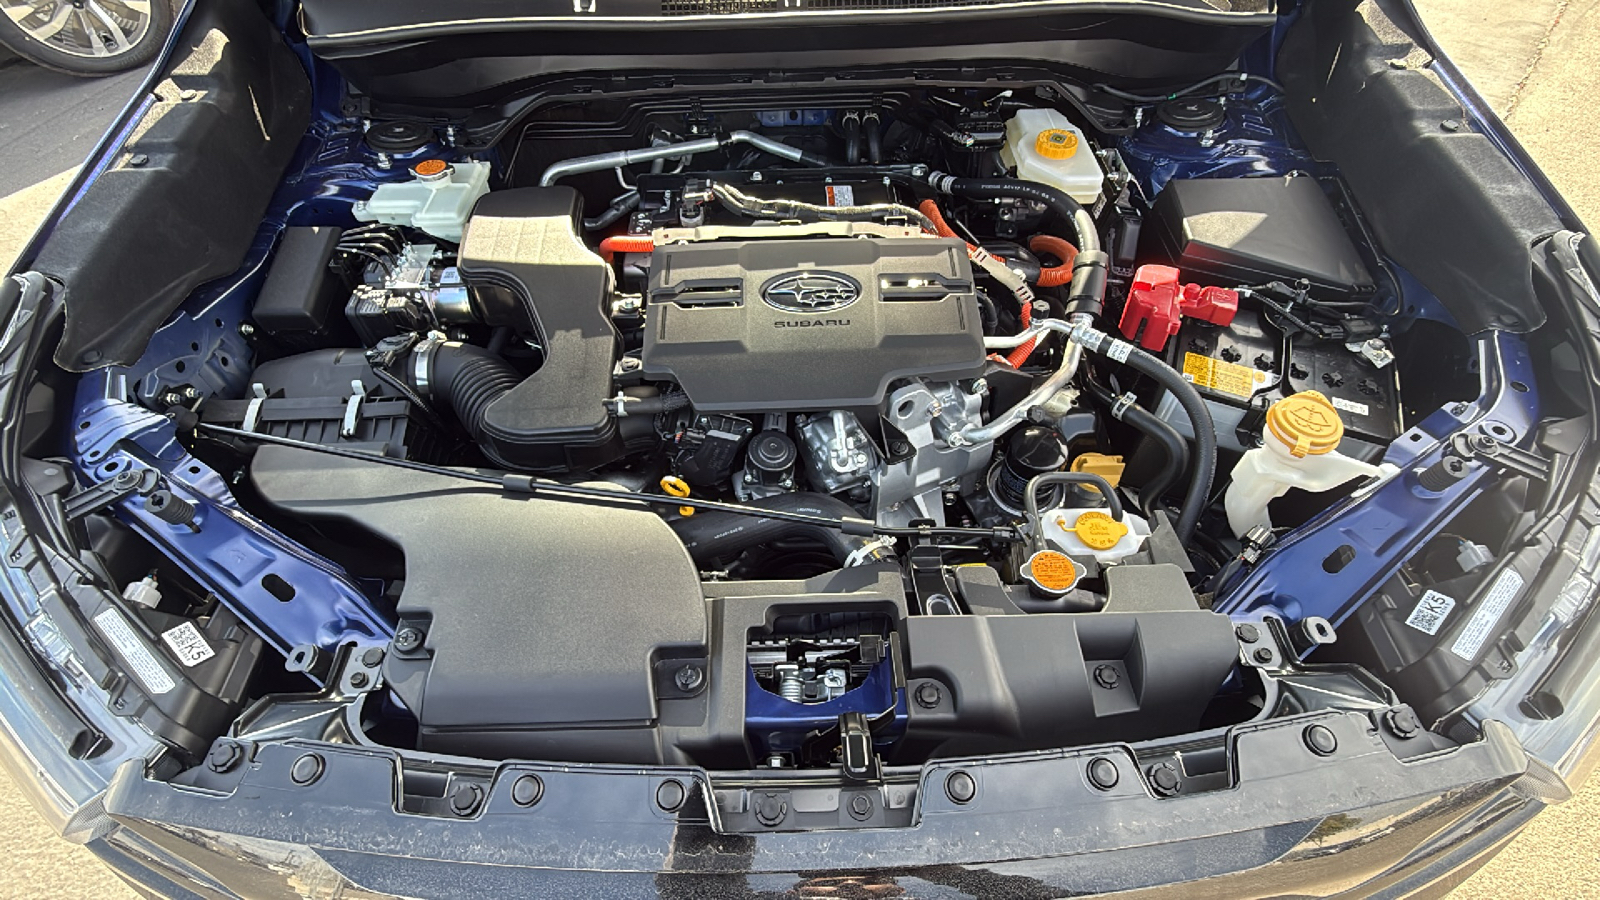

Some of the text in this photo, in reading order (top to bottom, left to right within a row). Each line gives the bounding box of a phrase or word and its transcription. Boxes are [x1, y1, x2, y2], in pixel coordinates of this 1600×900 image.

[774, 319, 851, 329] SUBARU
[1424, 594, 1446, 614] K5
[185, 642, 206, 661] K5
